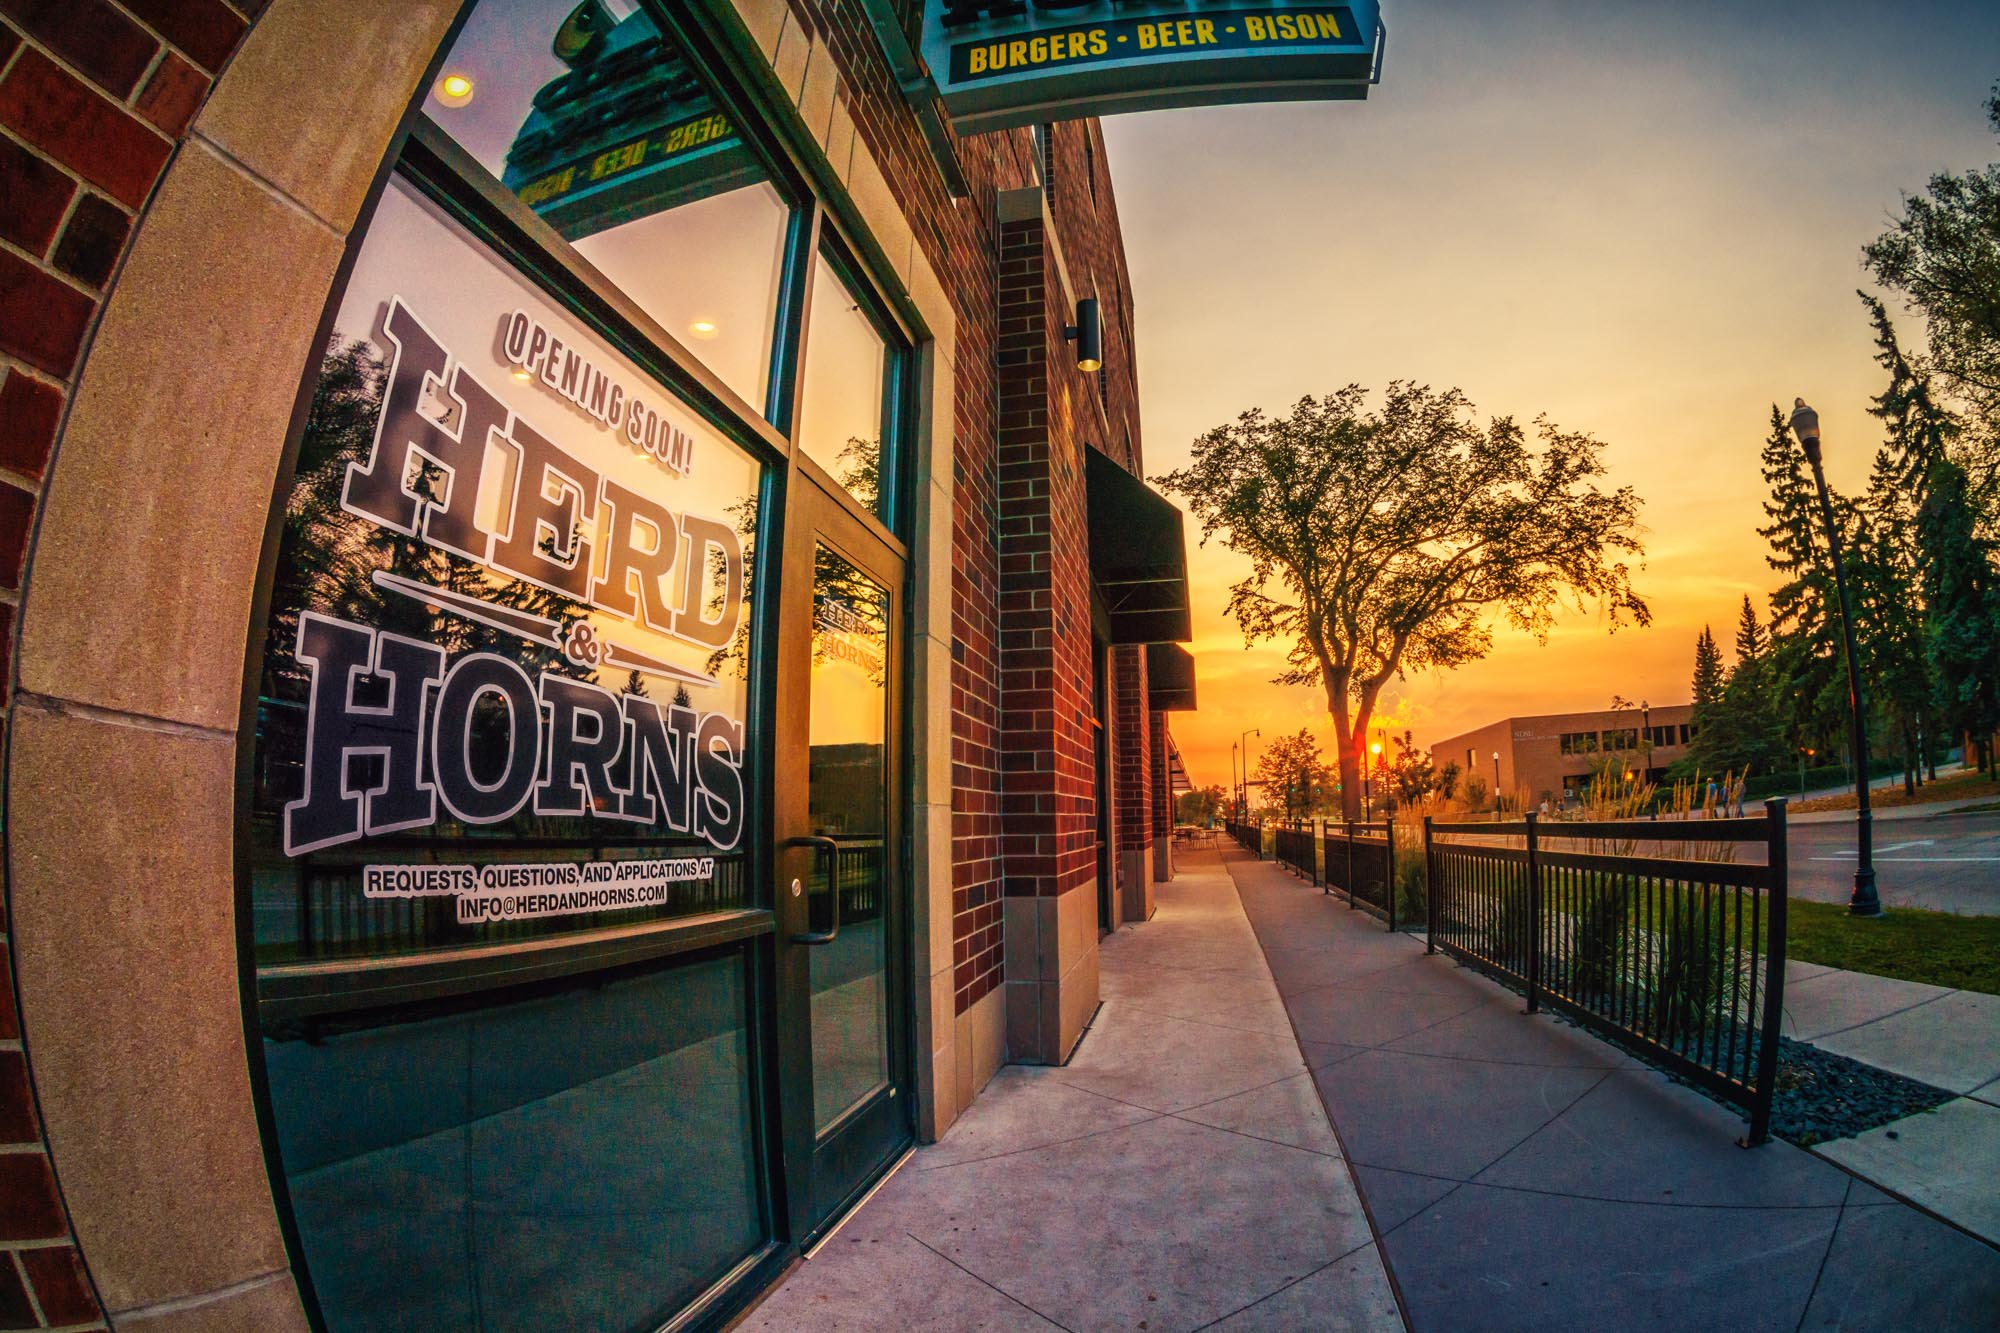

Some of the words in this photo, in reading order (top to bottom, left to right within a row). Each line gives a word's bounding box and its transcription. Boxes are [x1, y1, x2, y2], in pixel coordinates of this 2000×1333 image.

[970, 29, 1108, 74] BURGERS
[1137, 19, 1218, 49] BEER
[1244, 14, 1341, 41] BISON
[506, 311, 625, 427] OPENING
[629, 398, 695, 476] SOON!
[341, 295, 744, 651] HERD
[565, 620, 598, 669] &
[823, 597, 879, 643] HERD
[821, 630, 878, 674] HORNS
[284, 610, 744, 857] HORNS
[367, 870, 479, 893] REQUESTS,
[483, 867, 580, 889] QUESTIONS,
[583, 866, 613, 883] AND
[616, 862, 697, 881] APPLICATIONS
[699, 861, 712, 875] AT
[460, 885, 666, 919] INFO@HERDANDHORNS.COM
